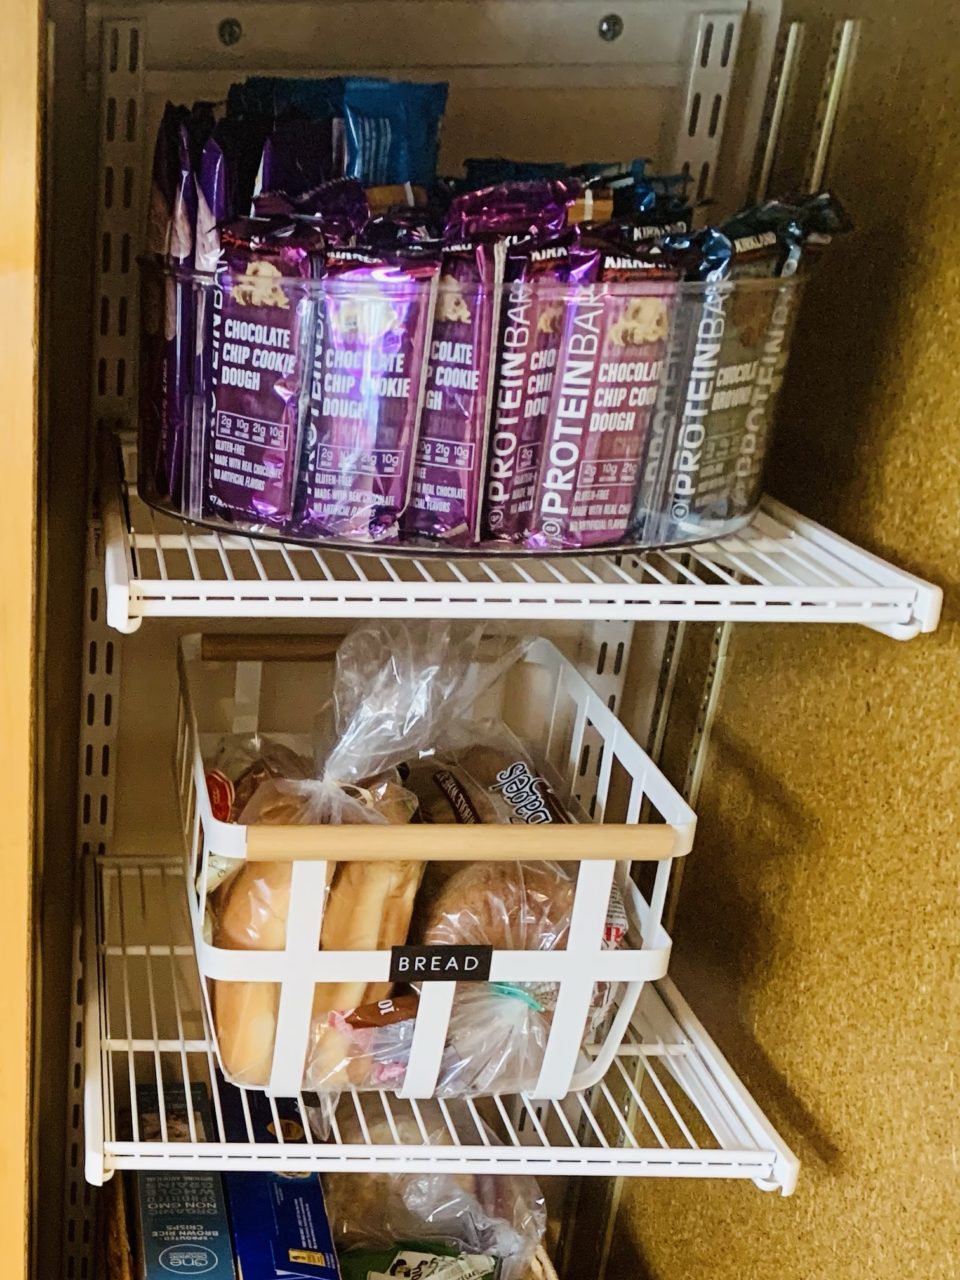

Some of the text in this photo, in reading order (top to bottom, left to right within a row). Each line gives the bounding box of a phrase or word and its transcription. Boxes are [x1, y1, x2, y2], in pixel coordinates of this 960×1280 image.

[224, 319, 290, 348] CHOCOLATE
[222, 343, 296, 374] CHIP COOKIE
[222, 366, 261, 391] DOUGH
[323, 374, 355, 396] CHIP
[435, 367, 480, 391] COOKIE
[322, 397, 367, 418] DOUGH
[593, 387, 628, 408] CHIP
[220, 417, 232, 429] 2g
[236, 418, 249, 432] 10g
[588, 411, 637, 433] DOUGH
[382, 452, 399, 465] 10g
[435, 443, 450, 456] 21g
[453, 445, 469, 459] 10g
[397, 956, 480, 973] BREAD
